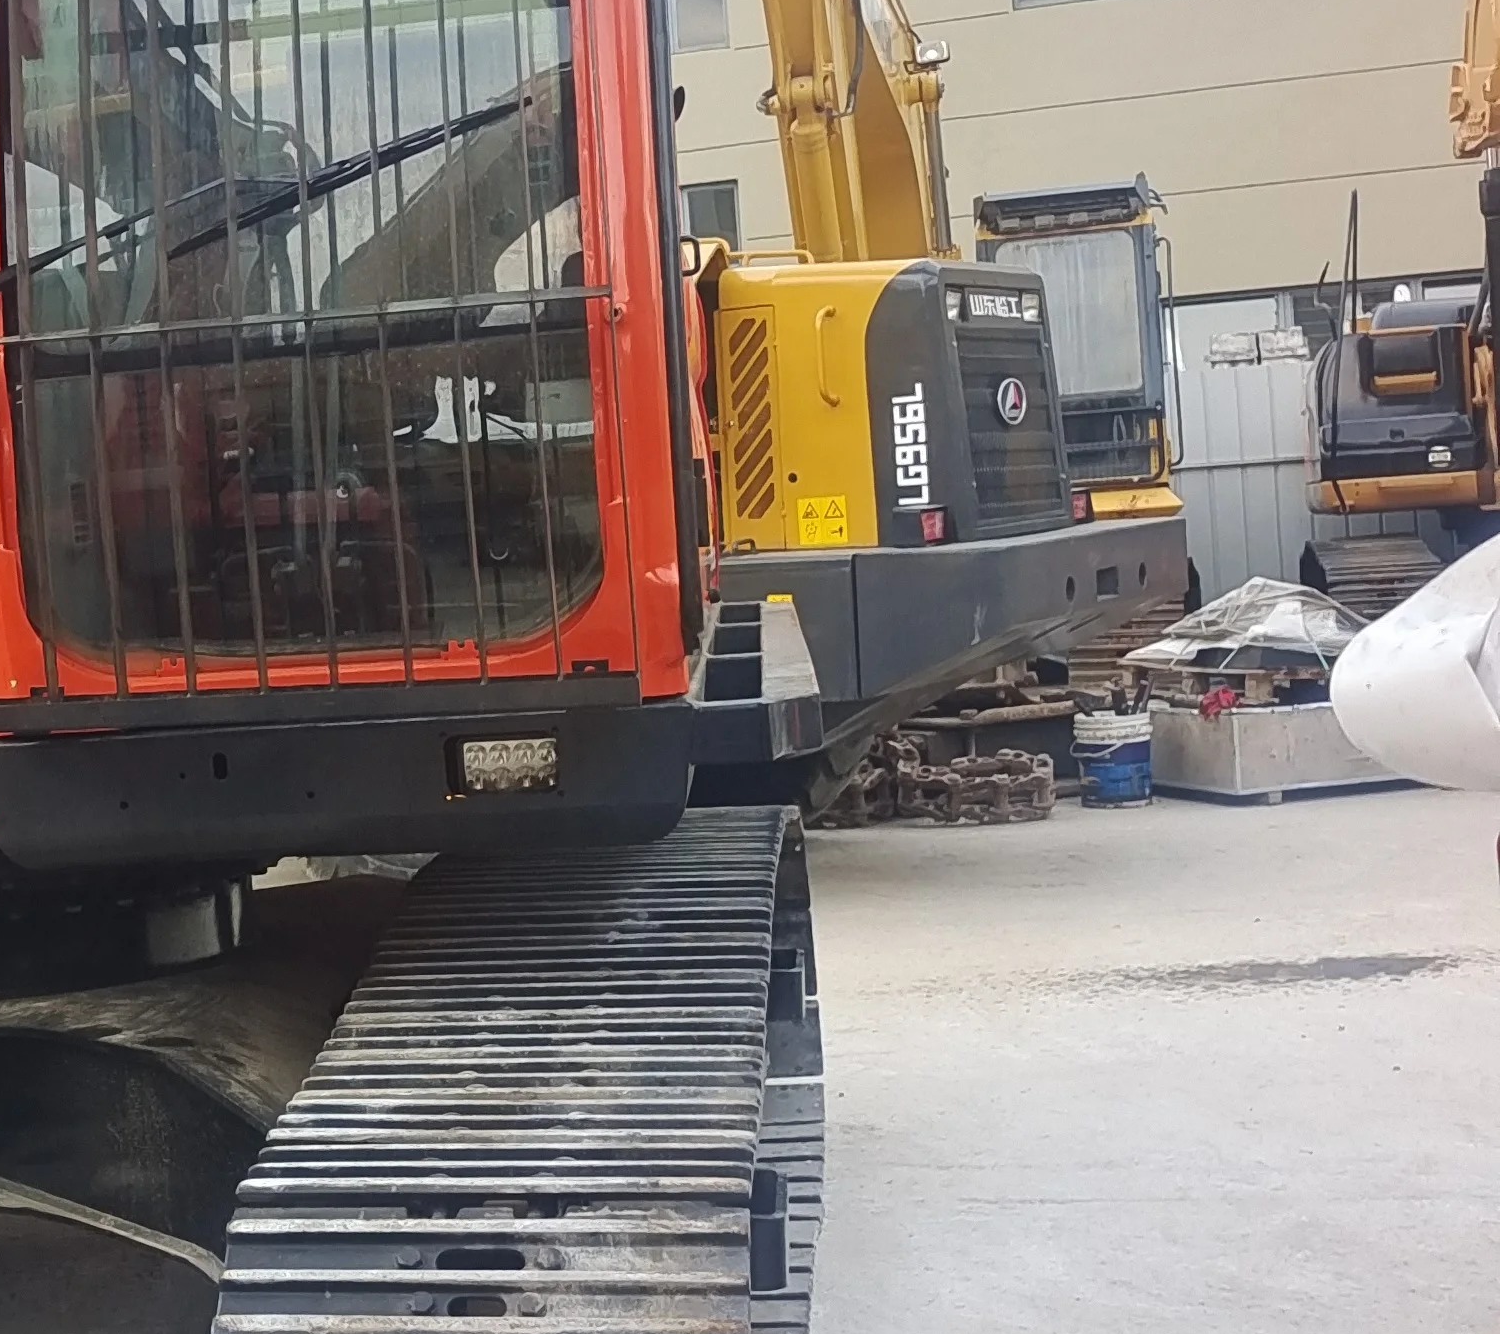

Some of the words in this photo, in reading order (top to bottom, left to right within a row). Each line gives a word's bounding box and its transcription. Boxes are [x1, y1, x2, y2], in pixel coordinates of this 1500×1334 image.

[969, 293, 1022, 319] 山东临工
[891, 382, 929, 506] LG956L
